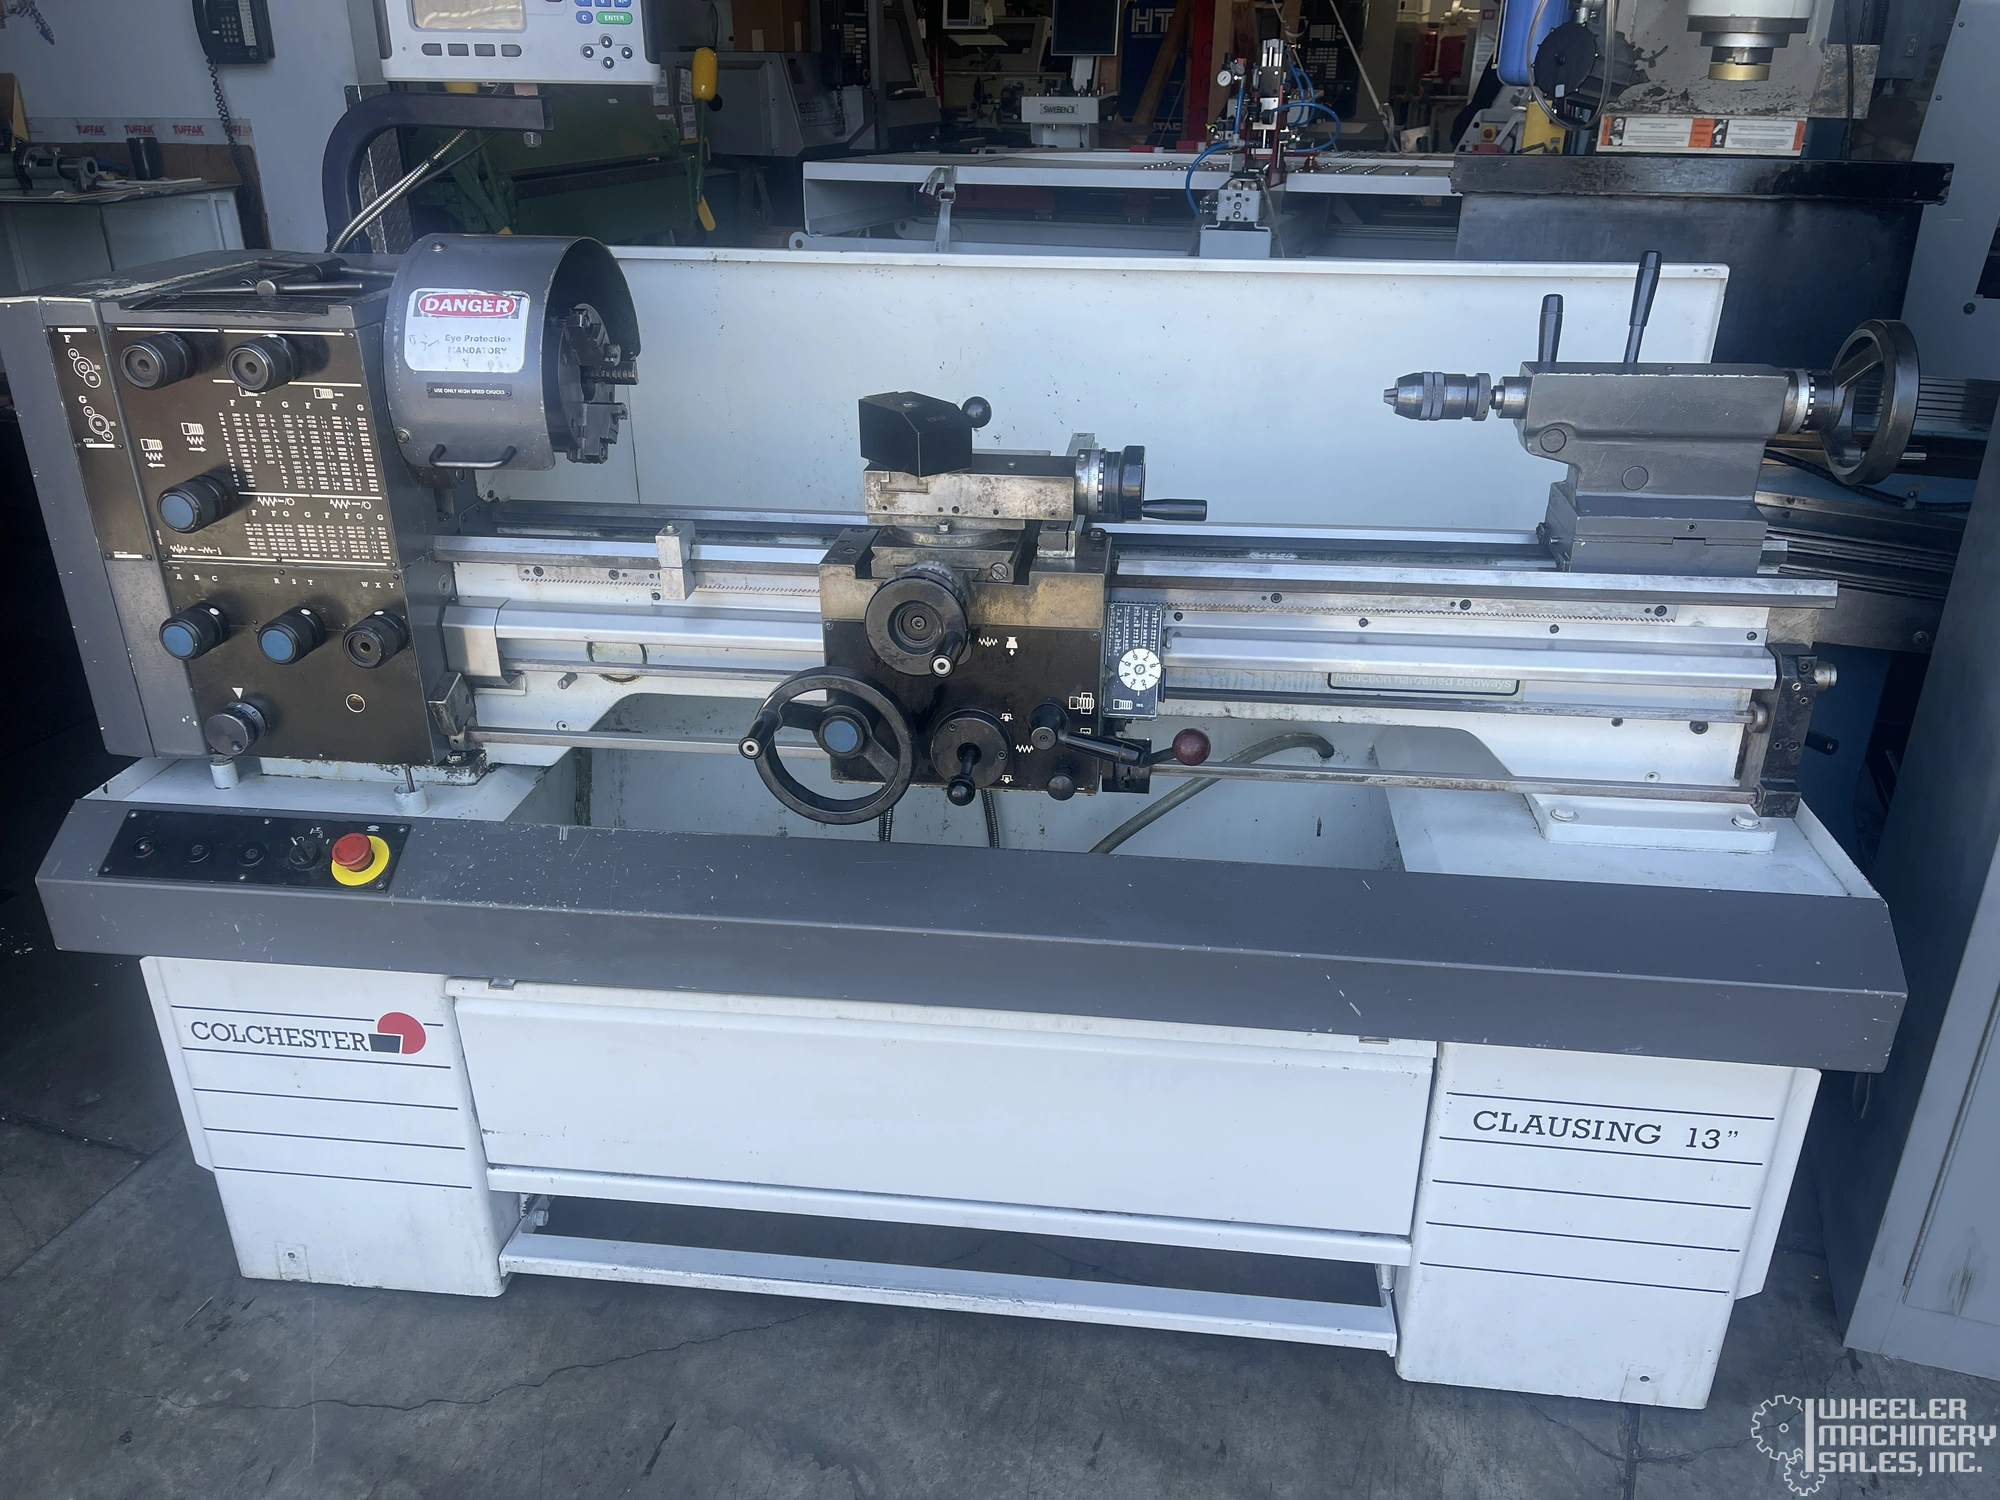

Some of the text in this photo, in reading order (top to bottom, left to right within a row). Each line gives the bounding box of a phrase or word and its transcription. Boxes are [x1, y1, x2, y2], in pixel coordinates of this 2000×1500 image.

[76, 124, 105, 136] TUFFAK
[124, 124, 154, 136] TUFFAK
[172, 124, 204, 136] TUFFAK
[425, 298, 510, 313] DANGER
[63, 334, 71, 344] F
[445, 334, 511, 343] Eye Protection
[78, 395, 87, 404] G
[229, 399, 364, 412] F F G F F G
[1336, 673, 1511, 690] Induction hardened bedways
[190, 1021, 369, 1052] COLCHESTER
[1473, 1110, 1662, 1145] CLAUSING
